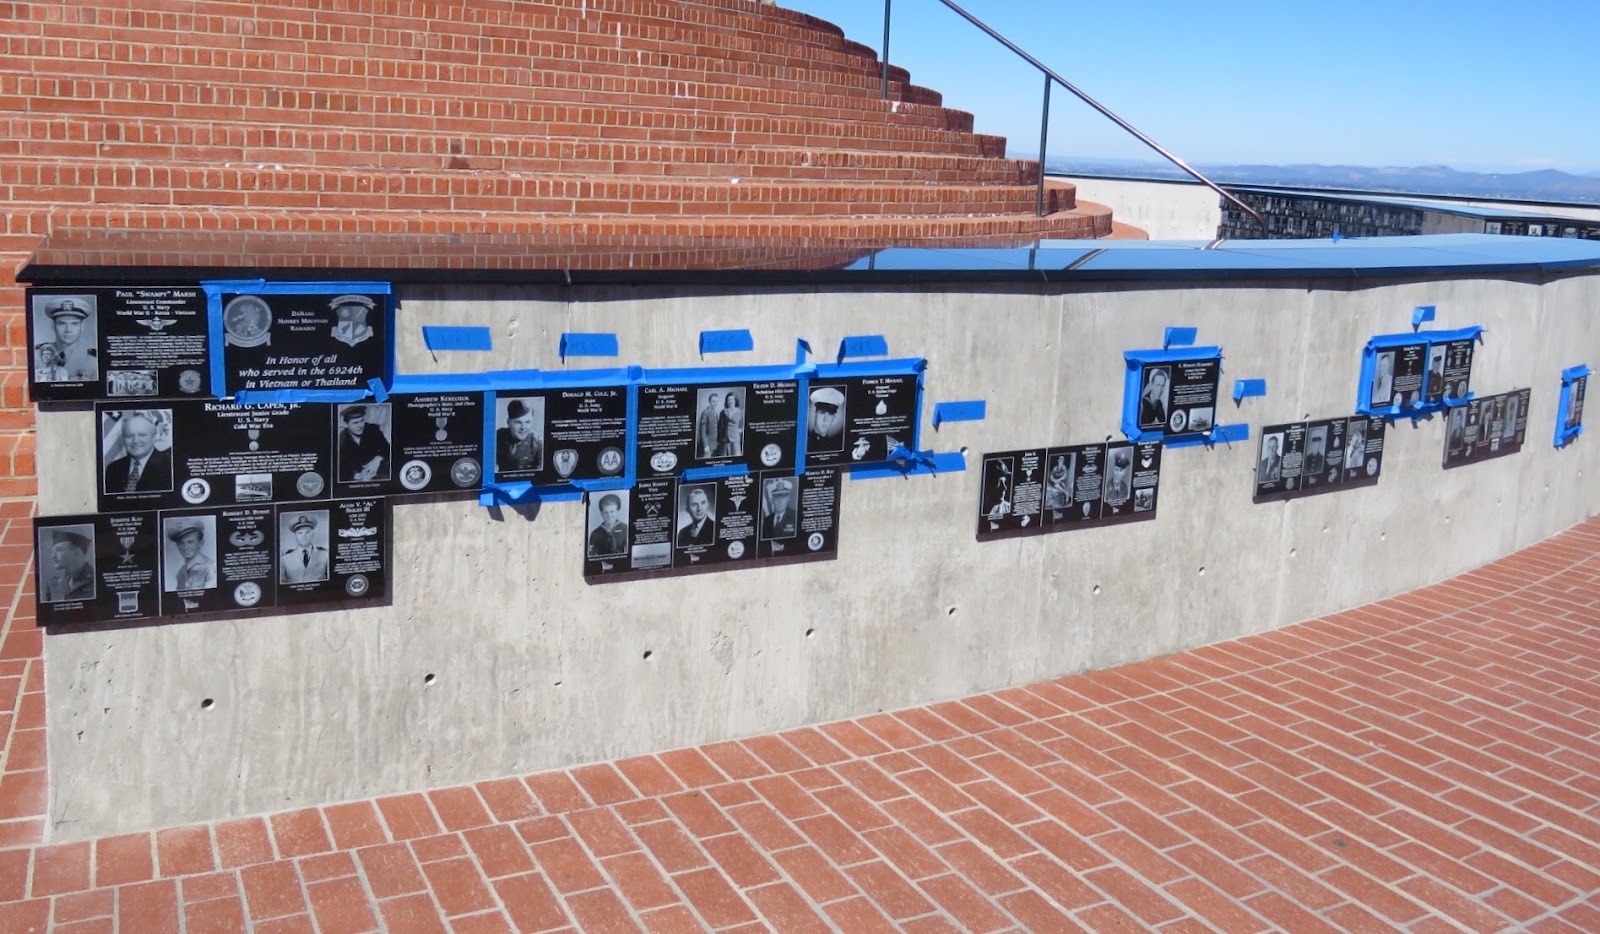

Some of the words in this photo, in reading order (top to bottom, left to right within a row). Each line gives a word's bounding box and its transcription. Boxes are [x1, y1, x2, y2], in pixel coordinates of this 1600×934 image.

[266, 357, 276, 365] In
[279, 356, 309, 364] Honor
[312, 355, 321, 366] of
[324, 355, 337, 363] all
[239, 368, 259, 377] who
[262, 367, 295, 376] served
[298, 367, 307, 376] in
[310, 366, 325, 375] the
[328, 366, 363, 375] 6924th
[246, 380, 256, 389] in
[259, 379, 298, 388] Vietnam
[314, 377, 357, 386] Thailand
[205, 402, 242, 411] RICHARD
